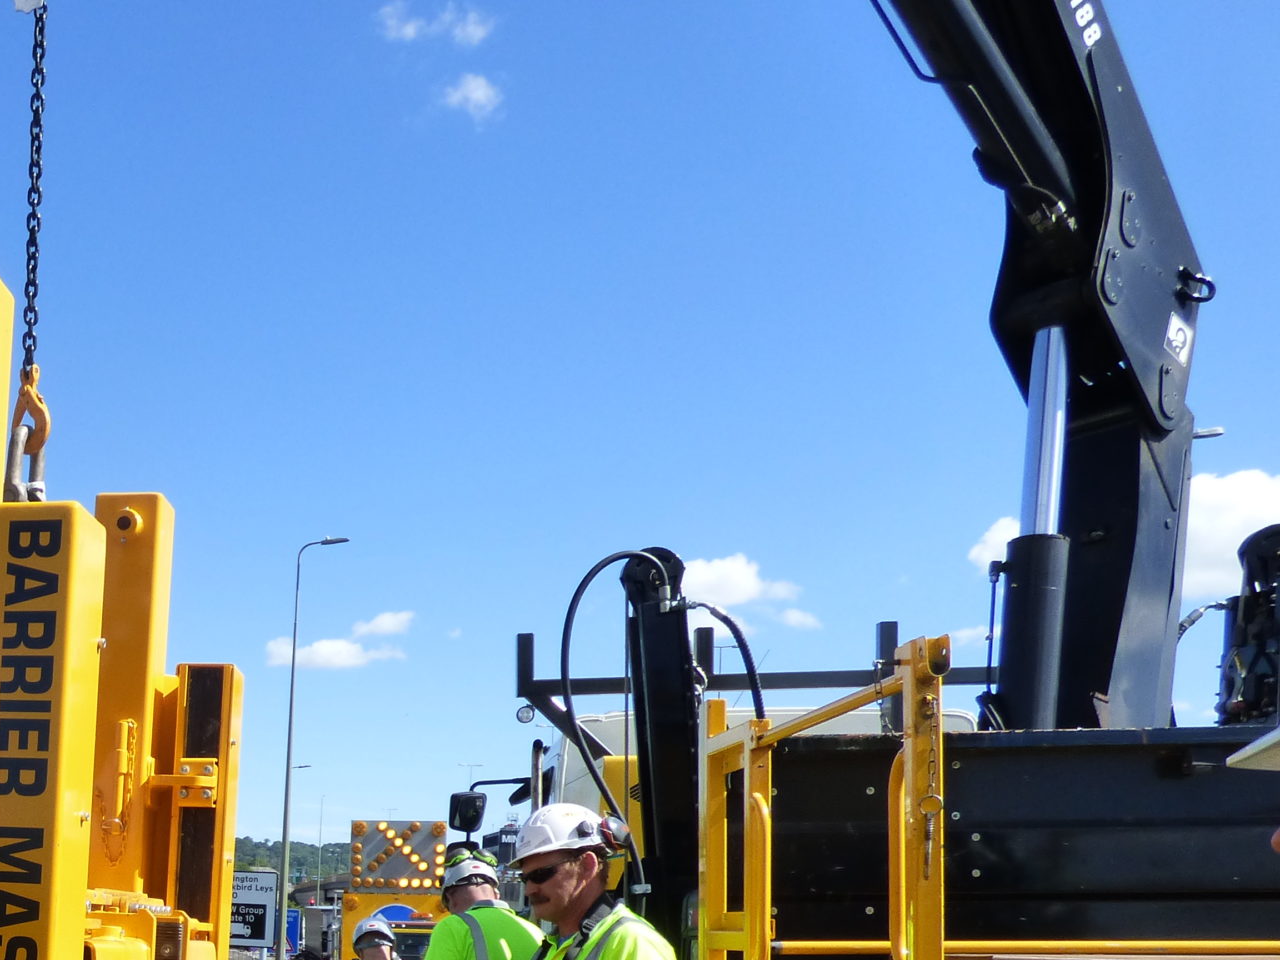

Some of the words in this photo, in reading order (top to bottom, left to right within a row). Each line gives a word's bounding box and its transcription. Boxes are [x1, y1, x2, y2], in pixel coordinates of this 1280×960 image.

[255, 884, 274, 893] Leys
[239, 905, 264, 915] Group
[245, 914, 255, 923] 10
